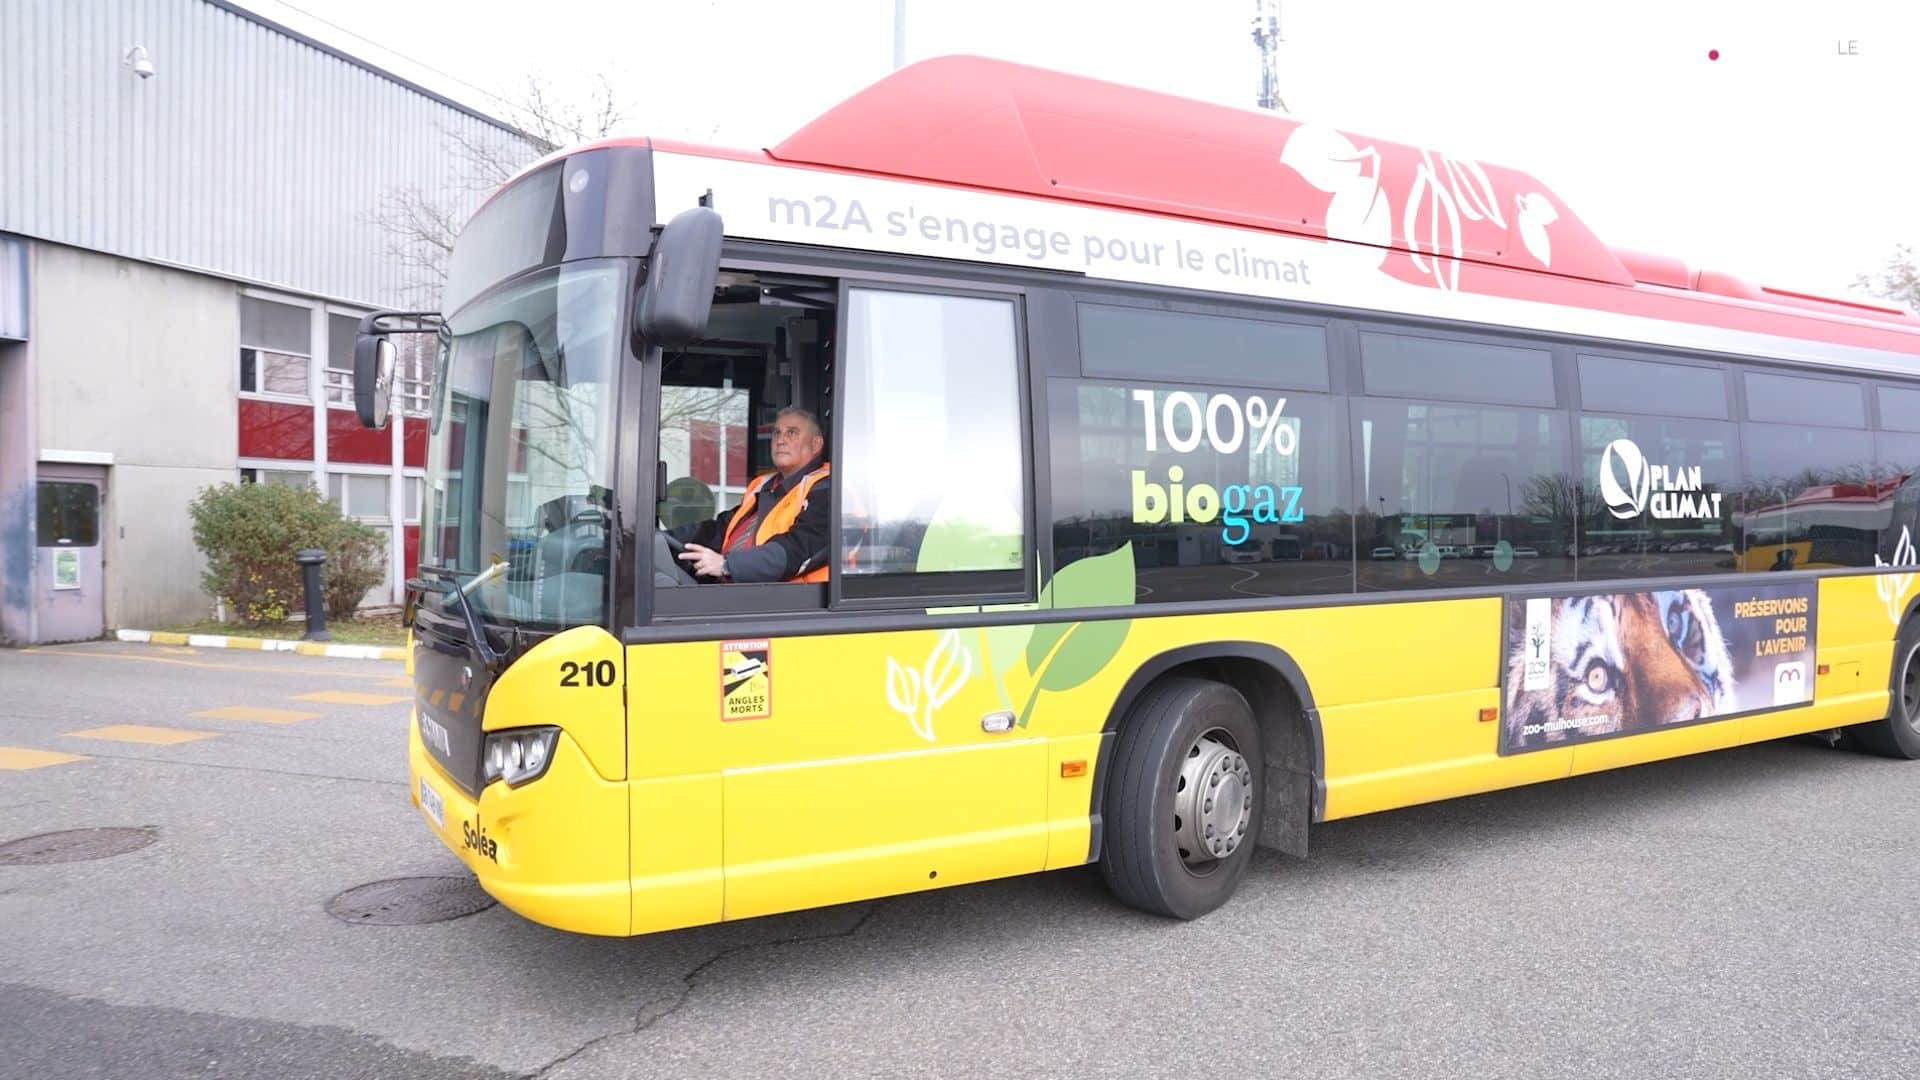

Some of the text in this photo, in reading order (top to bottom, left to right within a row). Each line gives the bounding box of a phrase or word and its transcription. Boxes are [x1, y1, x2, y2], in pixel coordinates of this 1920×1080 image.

[768, 194, 1312, 286] m2A s'engage pour le climat
[1132, 388, 1296, 456] 100%
[1650, 464, 1702, 491] PLAN
[1131, 465, 1304, 545] biogaz
[1650, 492, 1722, 519] CLIMAT
[1734, 596, 1809, 619] PRÉSERVONS
[1775, 617, 1807, 635] POUR
[724, 641, 768, 652] ATTENTION
[1756, 636, 1806, 657] L'AVENIR
[559, 659, 617, 687] 210
[729, 695, 764, 705] ANGLES
[730, 704, 763, 713] MORTS
[463, 813, 498, 864] Soléa
